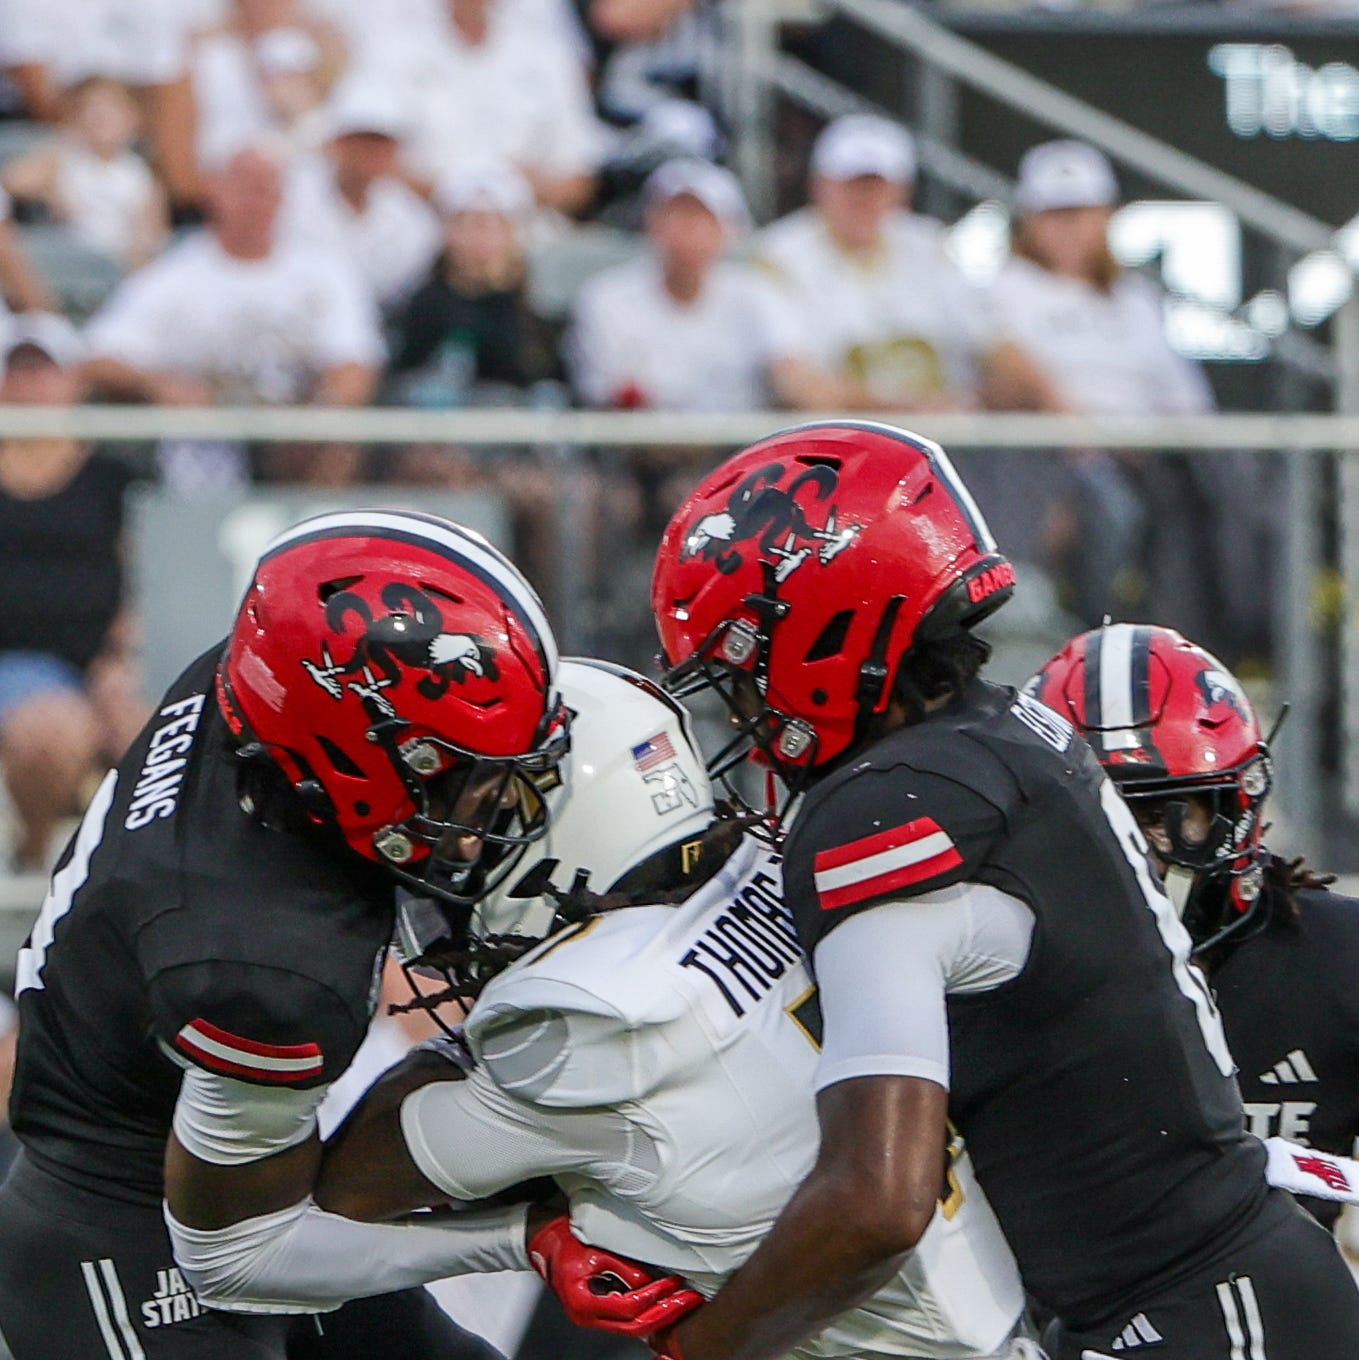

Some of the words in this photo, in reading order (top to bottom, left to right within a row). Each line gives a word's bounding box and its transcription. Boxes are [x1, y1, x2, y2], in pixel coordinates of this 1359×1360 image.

[124, 693, 207, 831] FEGANS
[153, 1266, 194, 1299] JA
[141, 1291, 210, 1329] STAT
